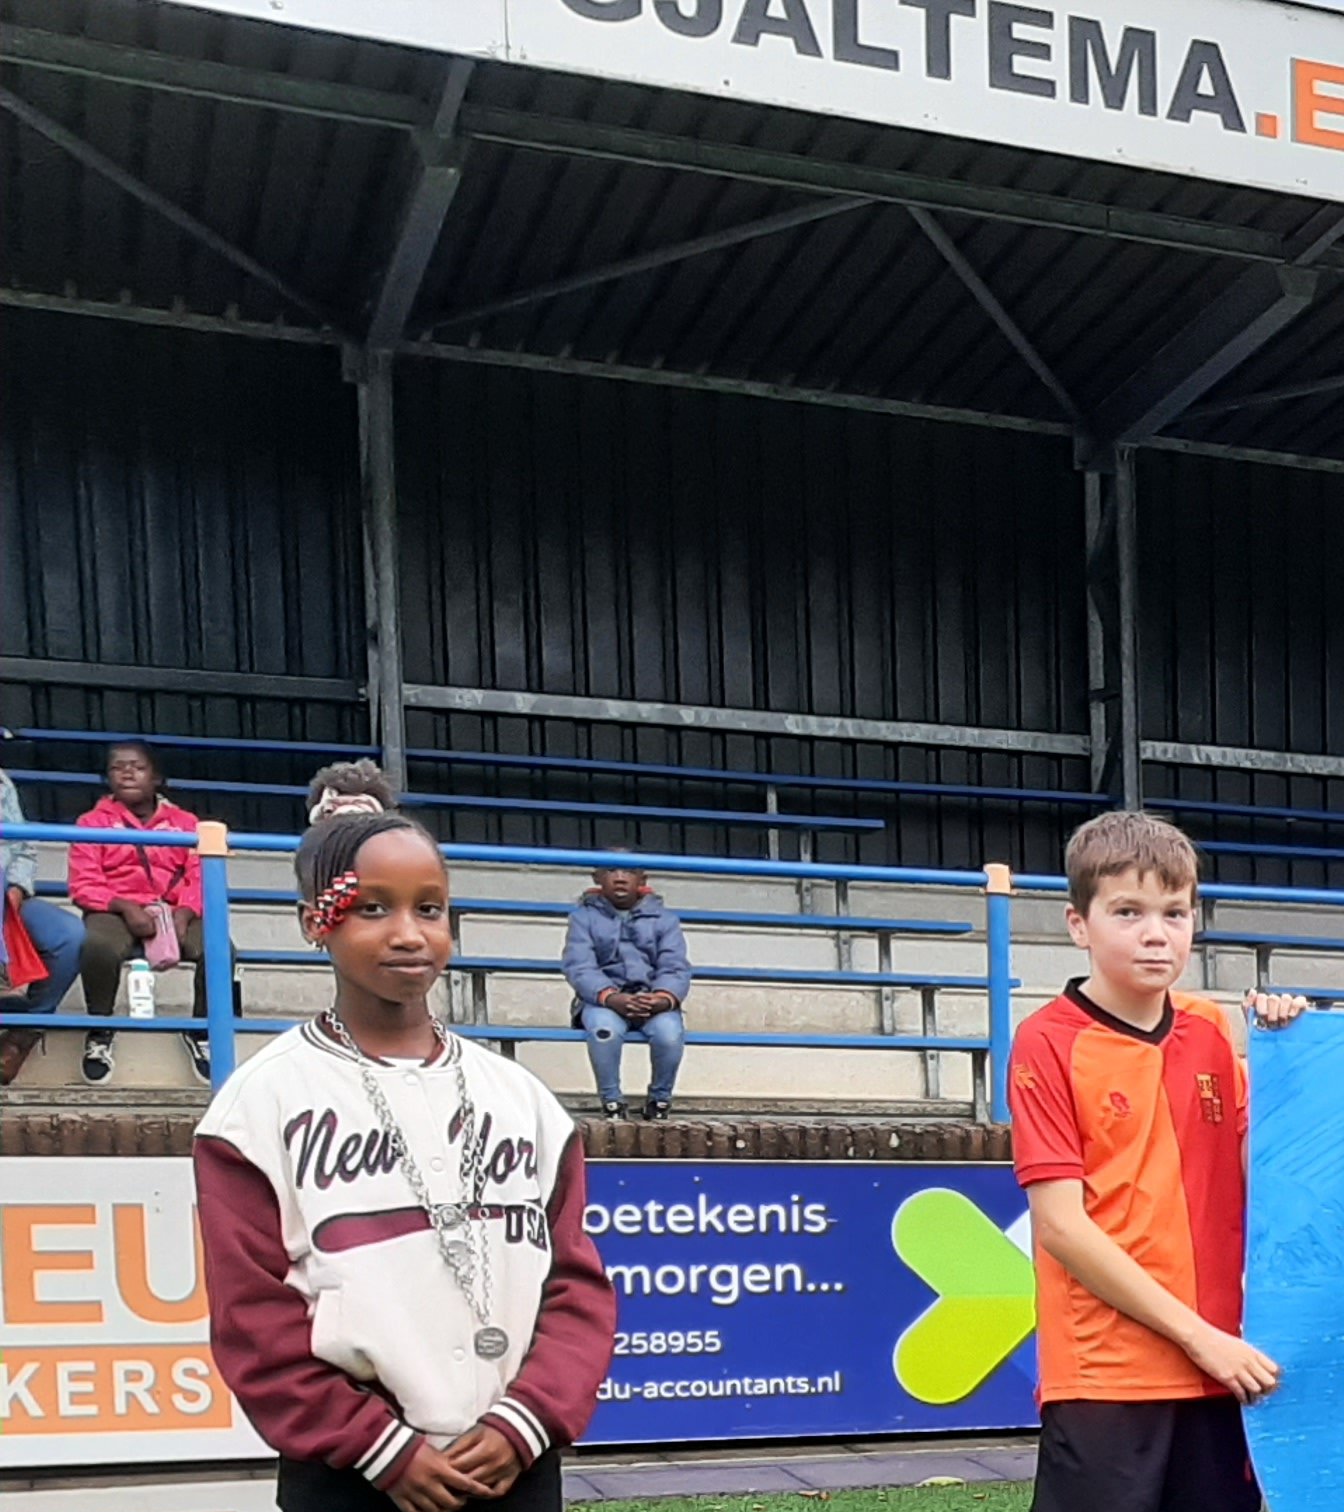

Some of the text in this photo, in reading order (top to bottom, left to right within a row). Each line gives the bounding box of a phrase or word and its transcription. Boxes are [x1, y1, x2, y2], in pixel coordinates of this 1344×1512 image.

[283, 1108, 401, 1190] New
[613, 1330, 721, 1355] 258955
[0, 1358, 213, 1419] KERS
